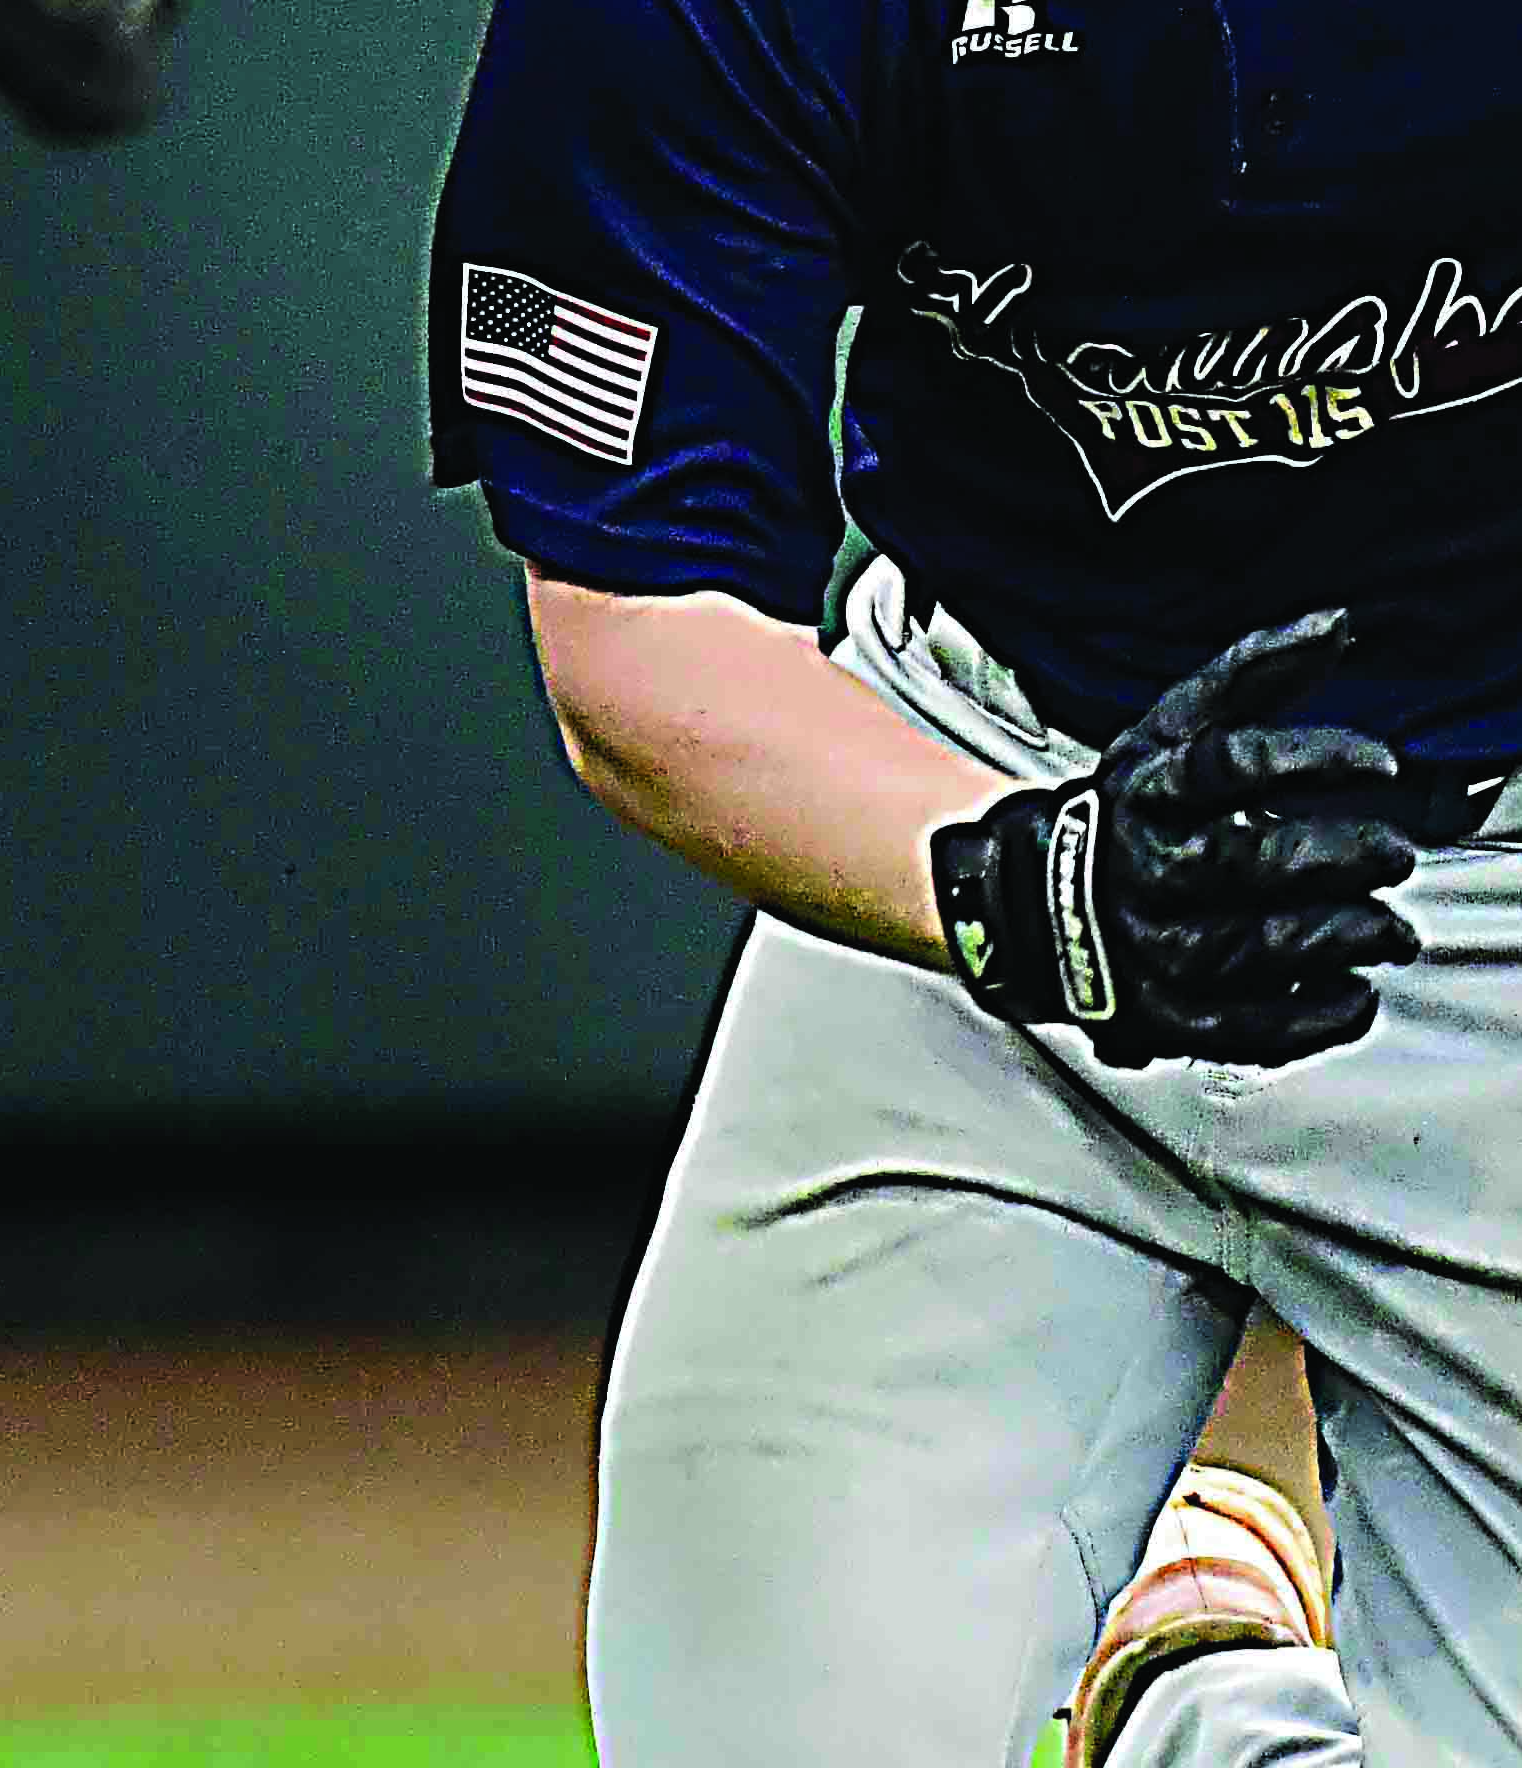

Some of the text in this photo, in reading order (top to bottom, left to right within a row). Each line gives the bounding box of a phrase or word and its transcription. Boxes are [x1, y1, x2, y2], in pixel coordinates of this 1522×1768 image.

[951, 31, 1079, 65] RUSSELL
[1078, 385, 1375, 451] POST 115
